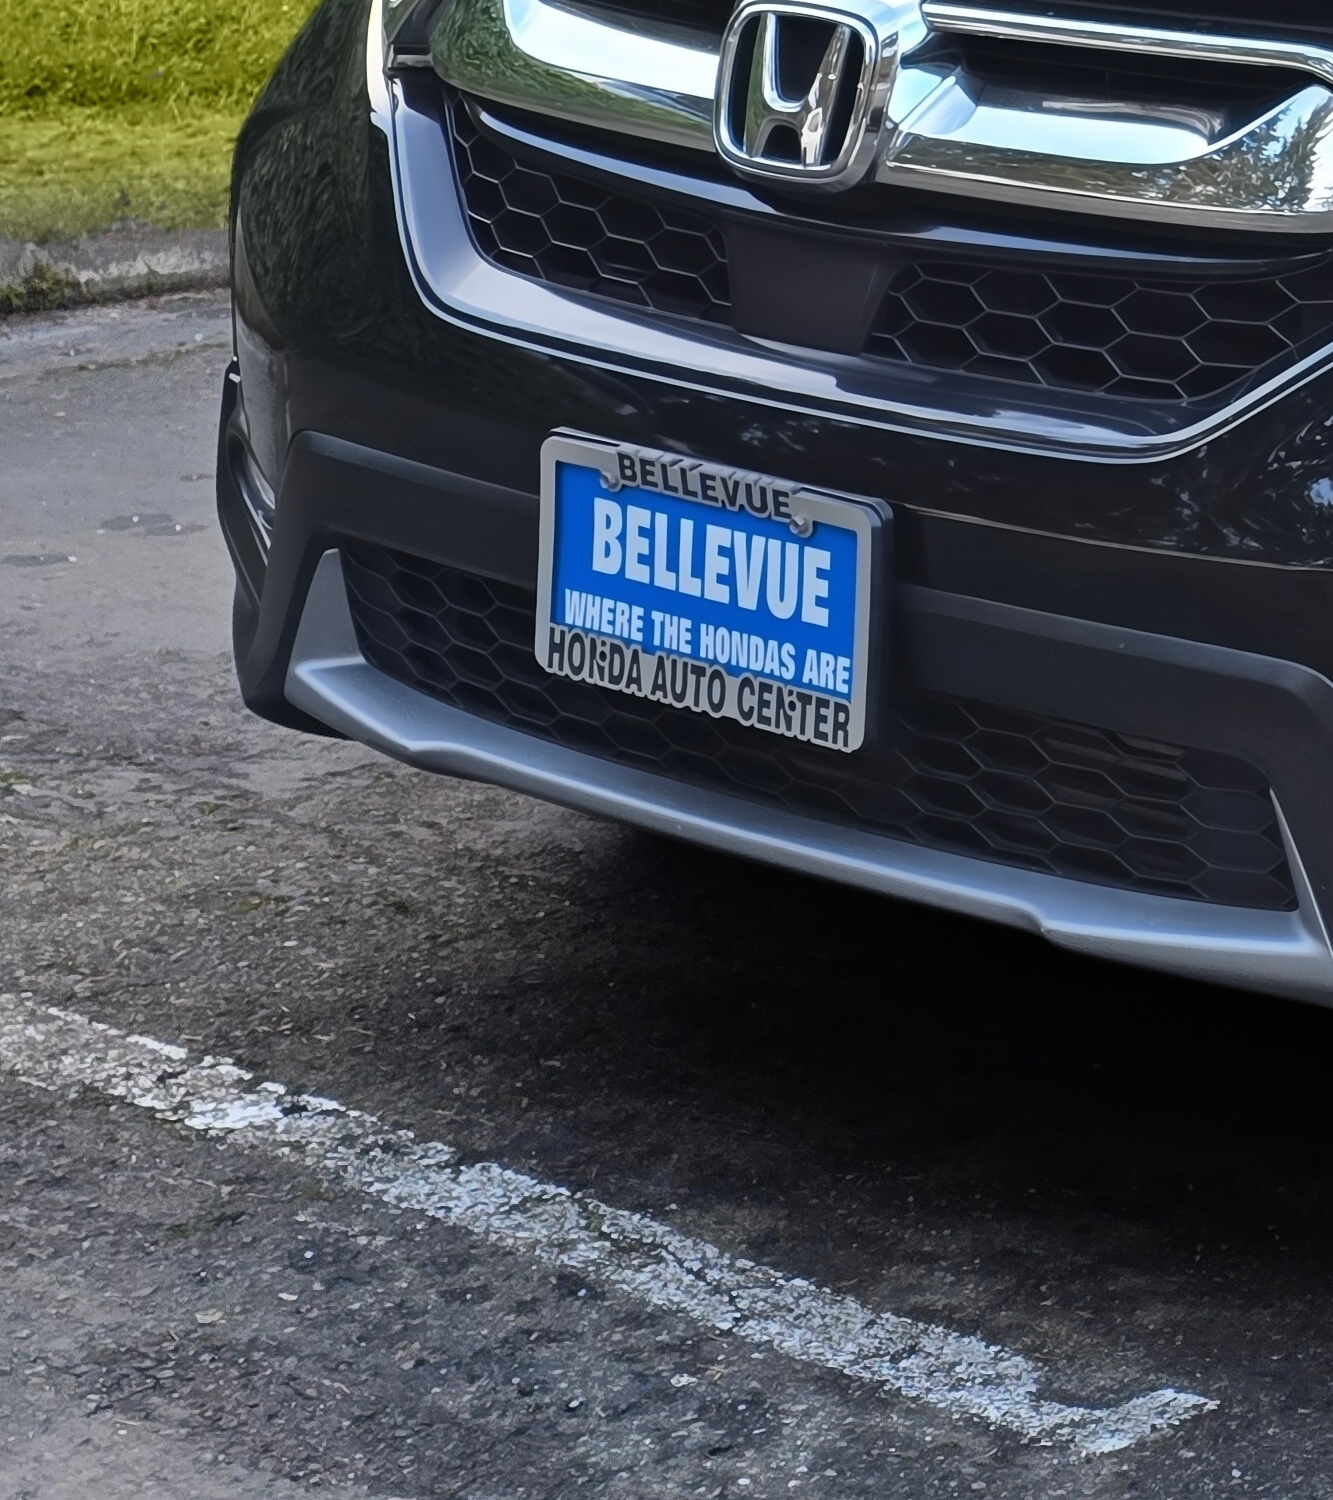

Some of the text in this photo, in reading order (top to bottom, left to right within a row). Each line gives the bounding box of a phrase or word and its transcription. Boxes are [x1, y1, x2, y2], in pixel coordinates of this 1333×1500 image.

[616, 451, 793, 520] BELLEVUE
[591, 496, 832, 628] BELLEVUE
[546, 626, 851, 748] HONDA AUTO CENTER
[563, 587, 852, 694] WHERE THE HONDAS ARE
